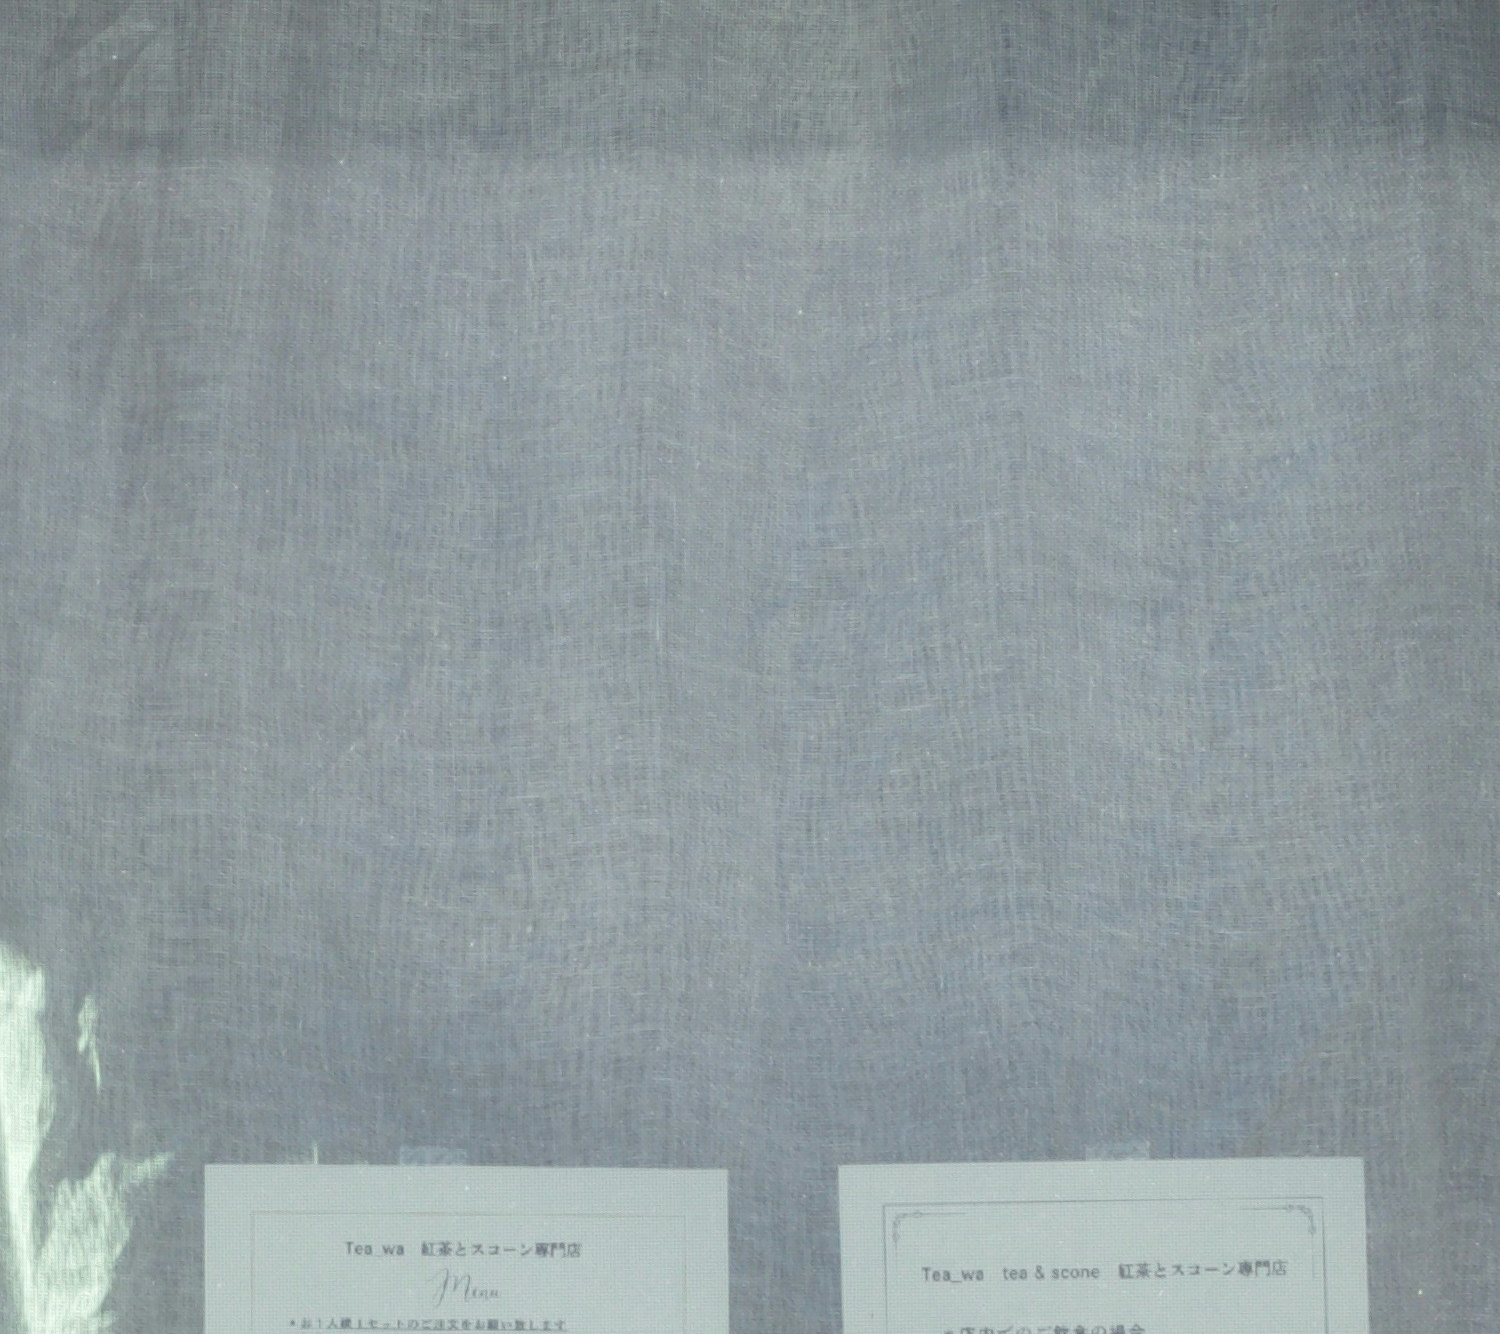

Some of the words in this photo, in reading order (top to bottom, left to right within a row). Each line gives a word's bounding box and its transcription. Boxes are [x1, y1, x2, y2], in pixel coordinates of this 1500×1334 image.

[420, 1241, 582, 1258] 紅茶とスコーン専門店
[922, 1267, 984, 1283] Tea_wa
[1002, 1267, 1028, 1280] tea
[1035, 1265, 1044, 1280] &
[1051, 1267, 1101, 1280] scone
[1118, 1259, 1288, 1279] 紅茶とスコーン専門店
[432, 1267, 500, 1308] Menu
